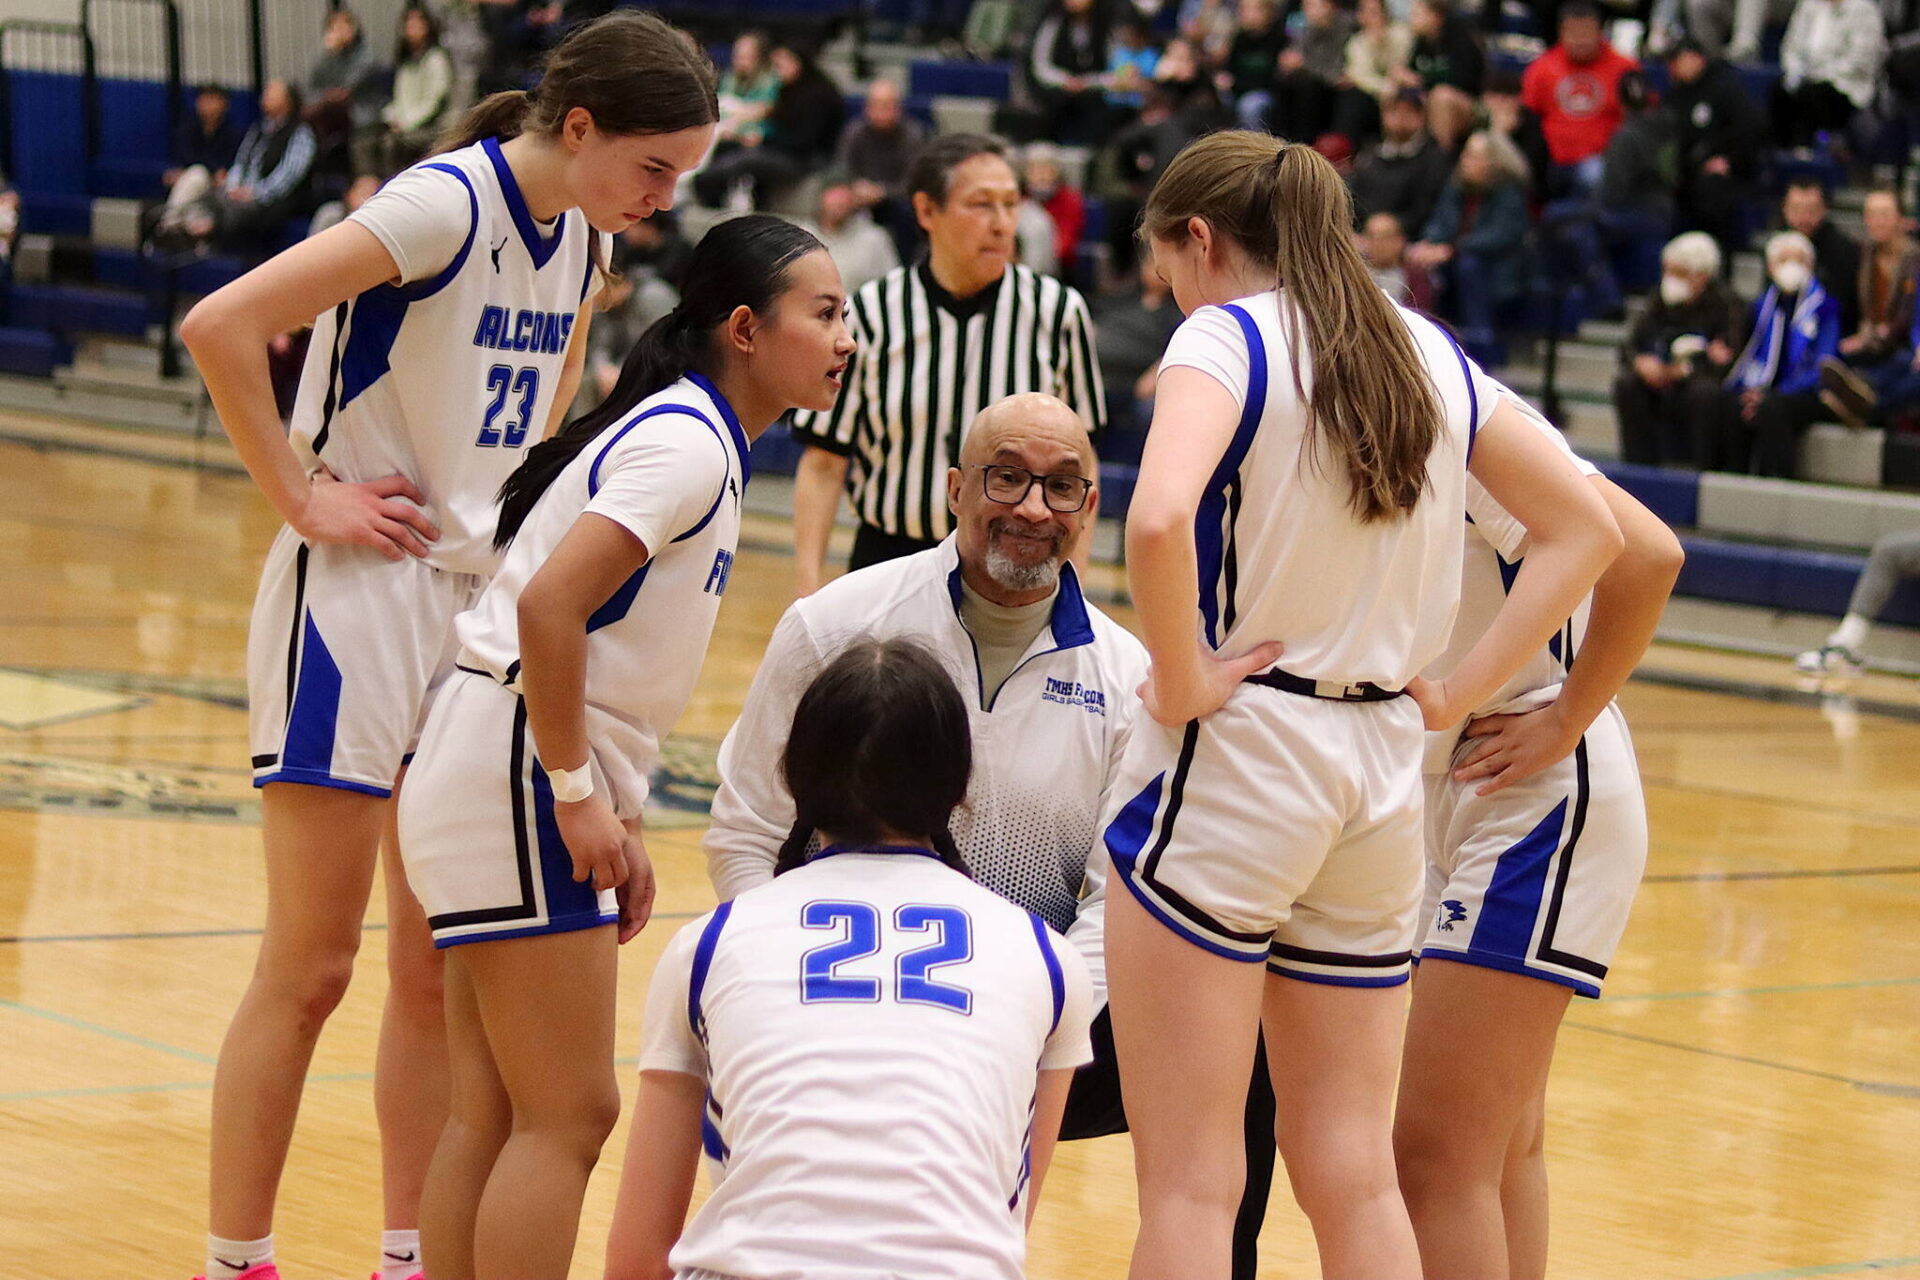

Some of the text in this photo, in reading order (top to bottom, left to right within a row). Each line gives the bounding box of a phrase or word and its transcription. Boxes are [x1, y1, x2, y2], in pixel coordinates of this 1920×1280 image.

[473, 304, 575, 354] ALCONS
[475, 363, 540, 449] 23
[1041, 692, 1066, 704] GIRLS
[1045, 677, 1074, 696] TMHS
[800, 899, 974, 1016] 22
